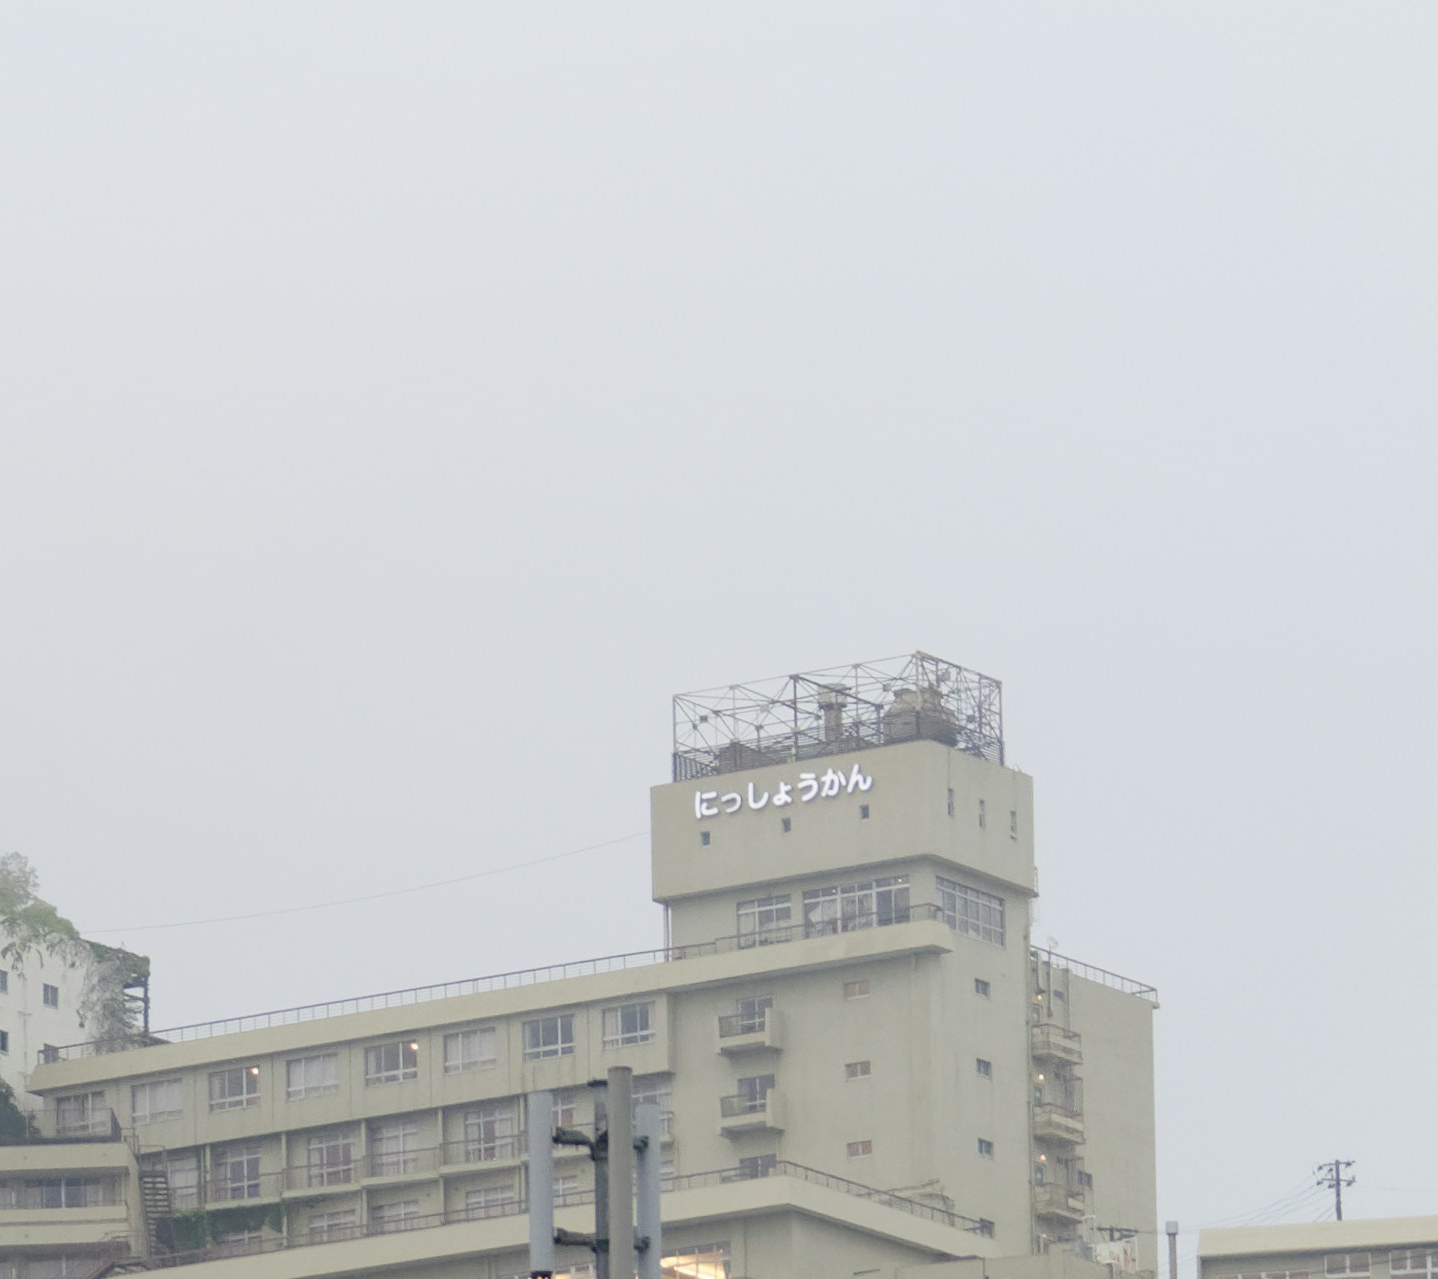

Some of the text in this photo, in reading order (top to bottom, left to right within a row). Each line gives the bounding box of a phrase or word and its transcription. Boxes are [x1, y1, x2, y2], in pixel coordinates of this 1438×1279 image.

[694, 763, 872, 819] にっしょうかん
